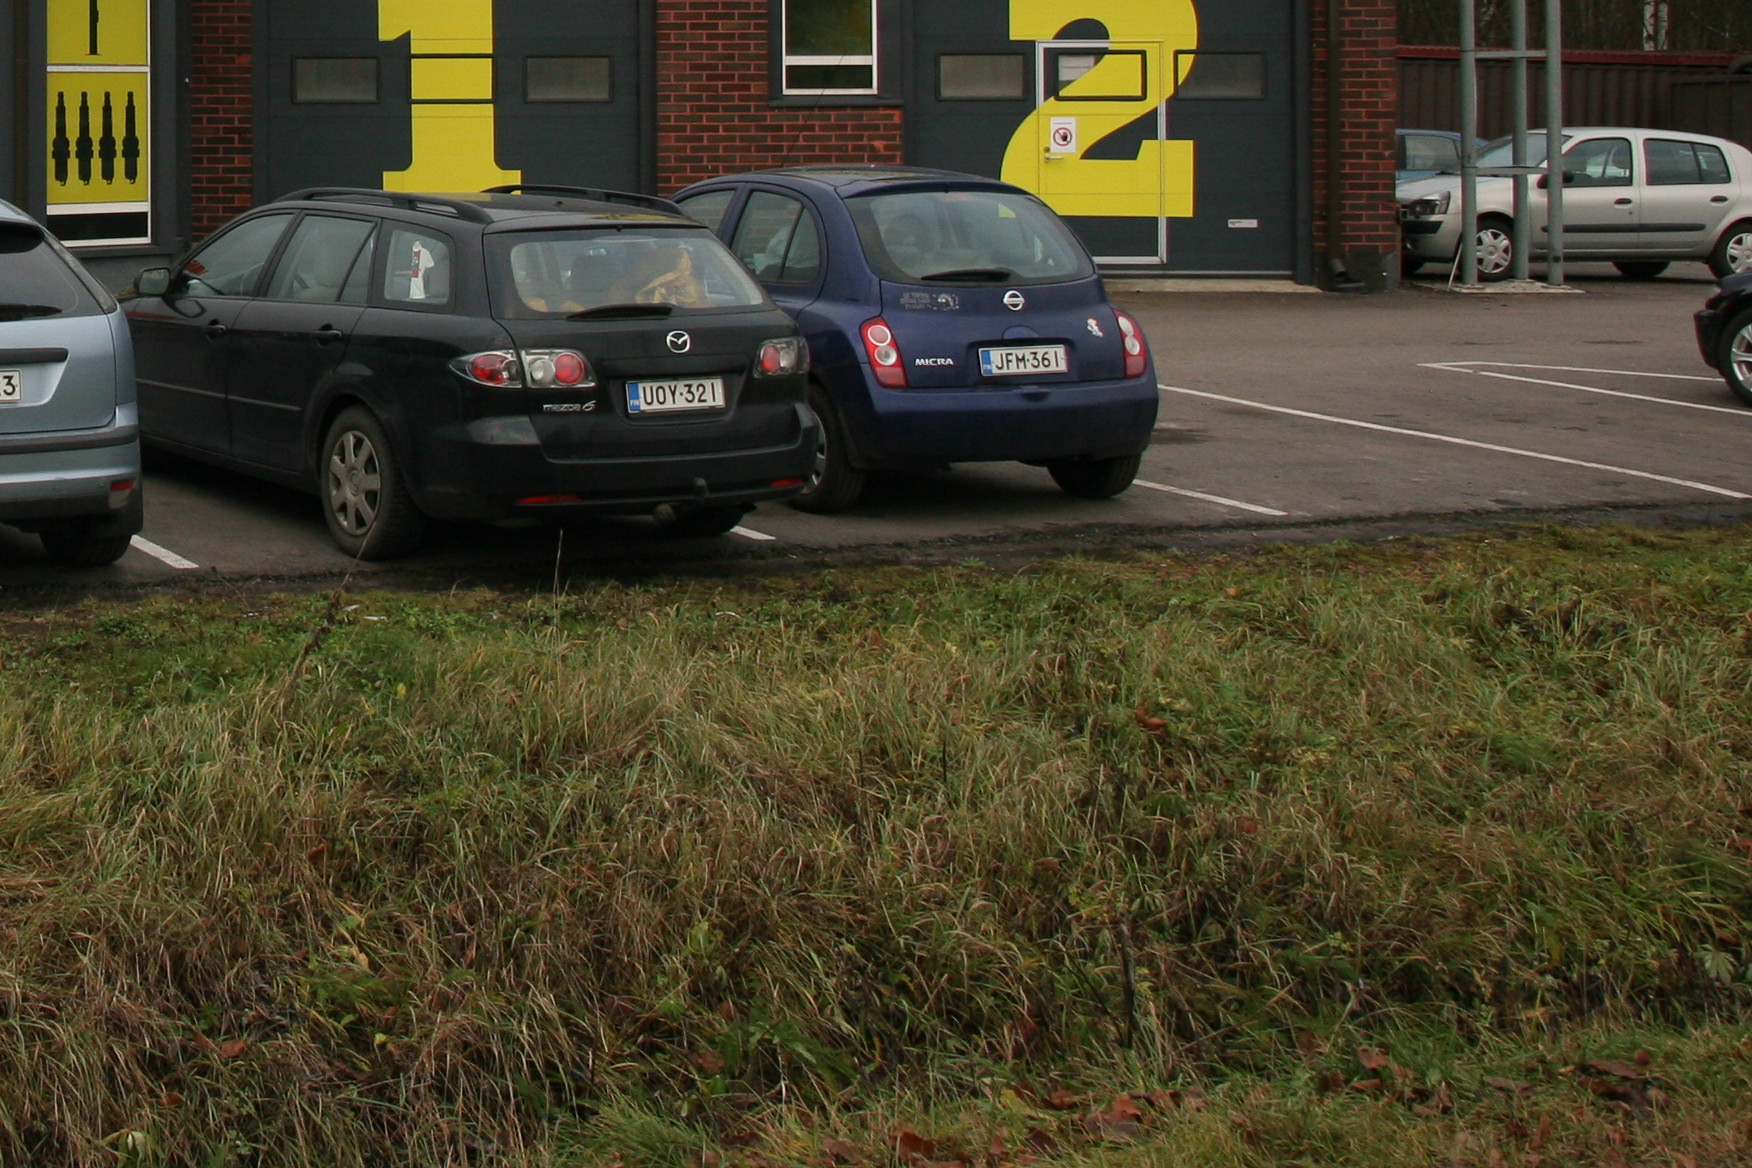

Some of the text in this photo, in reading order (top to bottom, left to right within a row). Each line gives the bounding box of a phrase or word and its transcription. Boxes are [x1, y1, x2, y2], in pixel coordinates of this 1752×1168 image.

[914, 358, 954, 366] MICRA
[995, 350, 1059, 370] JFM-361
[642, 382, 716, 405] UOY-321
[582, 400, 596, 412] 6
